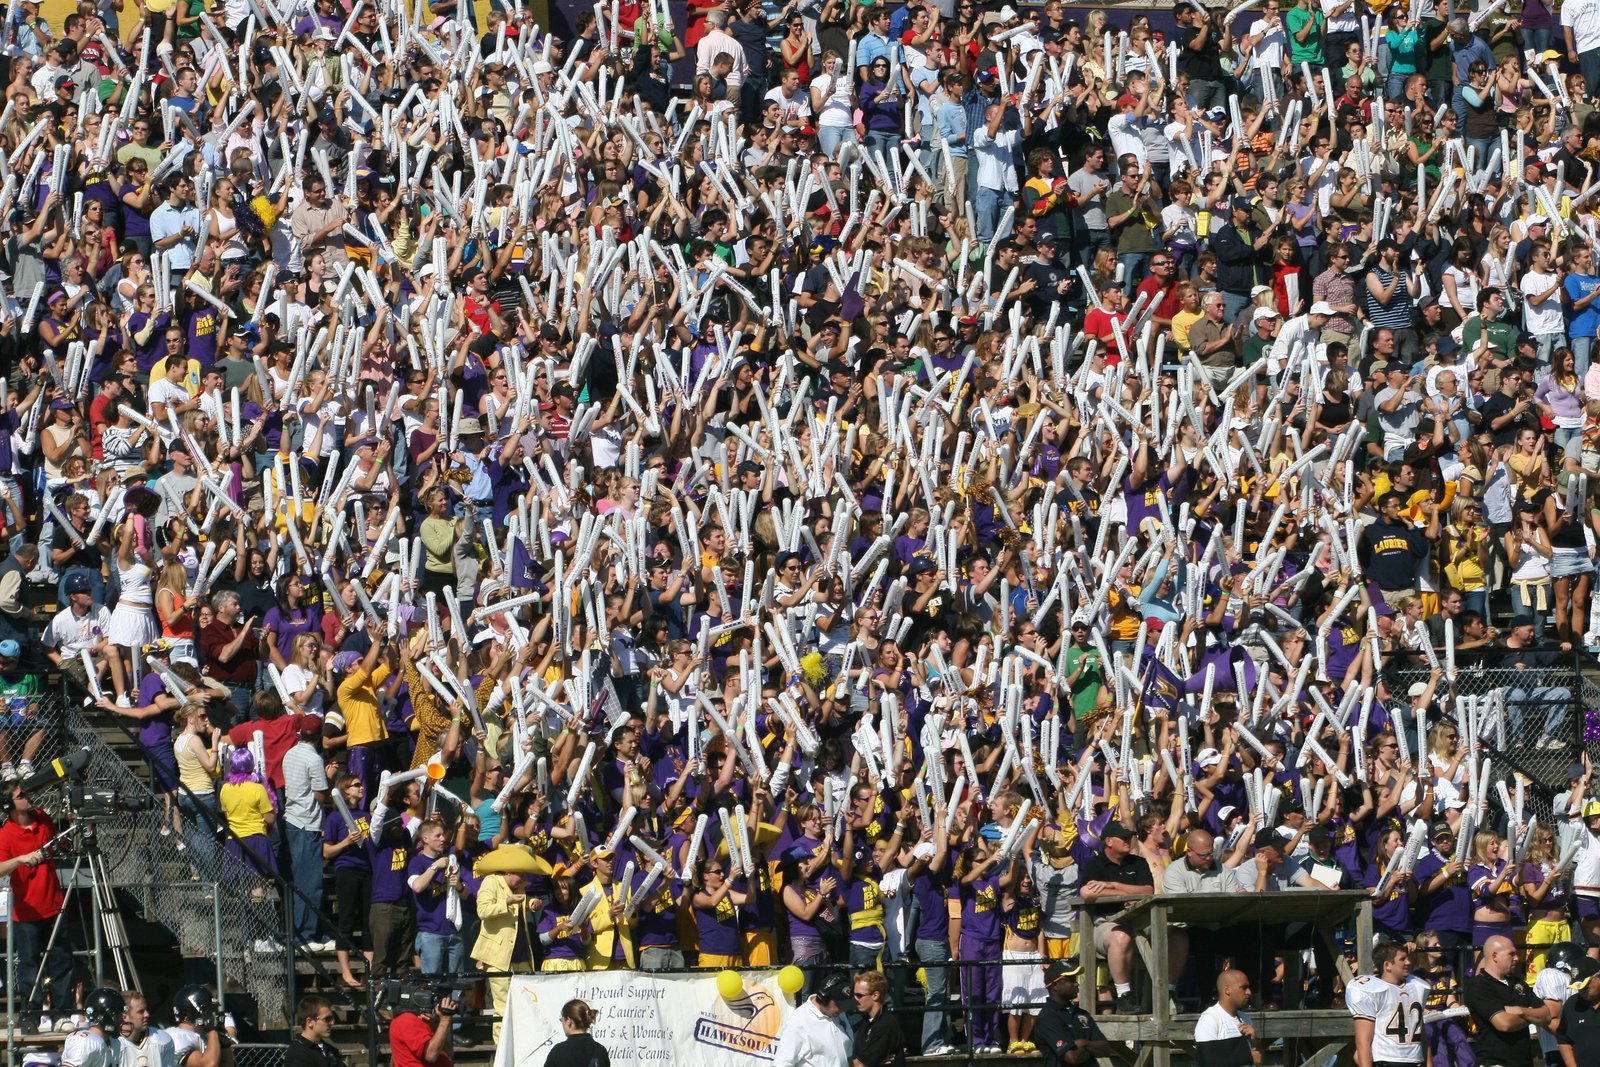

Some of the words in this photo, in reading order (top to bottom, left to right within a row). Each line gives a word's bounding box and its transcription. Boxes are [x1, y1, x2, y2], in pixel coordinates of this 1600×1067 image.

[1374, 538, 1409, 555] LAURIER
[574, 987, 587, 999] In
[591, 985, 624, 1000] Proud
[628, 985, 666, 1000] Support
[607, 1005, 655, 1019] Laurier's
[1384, 999, 1424, 1046] 42
[620, 1025, 629, 1041] &
[632, 1025, 674, 1041] Women's
[638, 1046, 671, 1060] Teams
